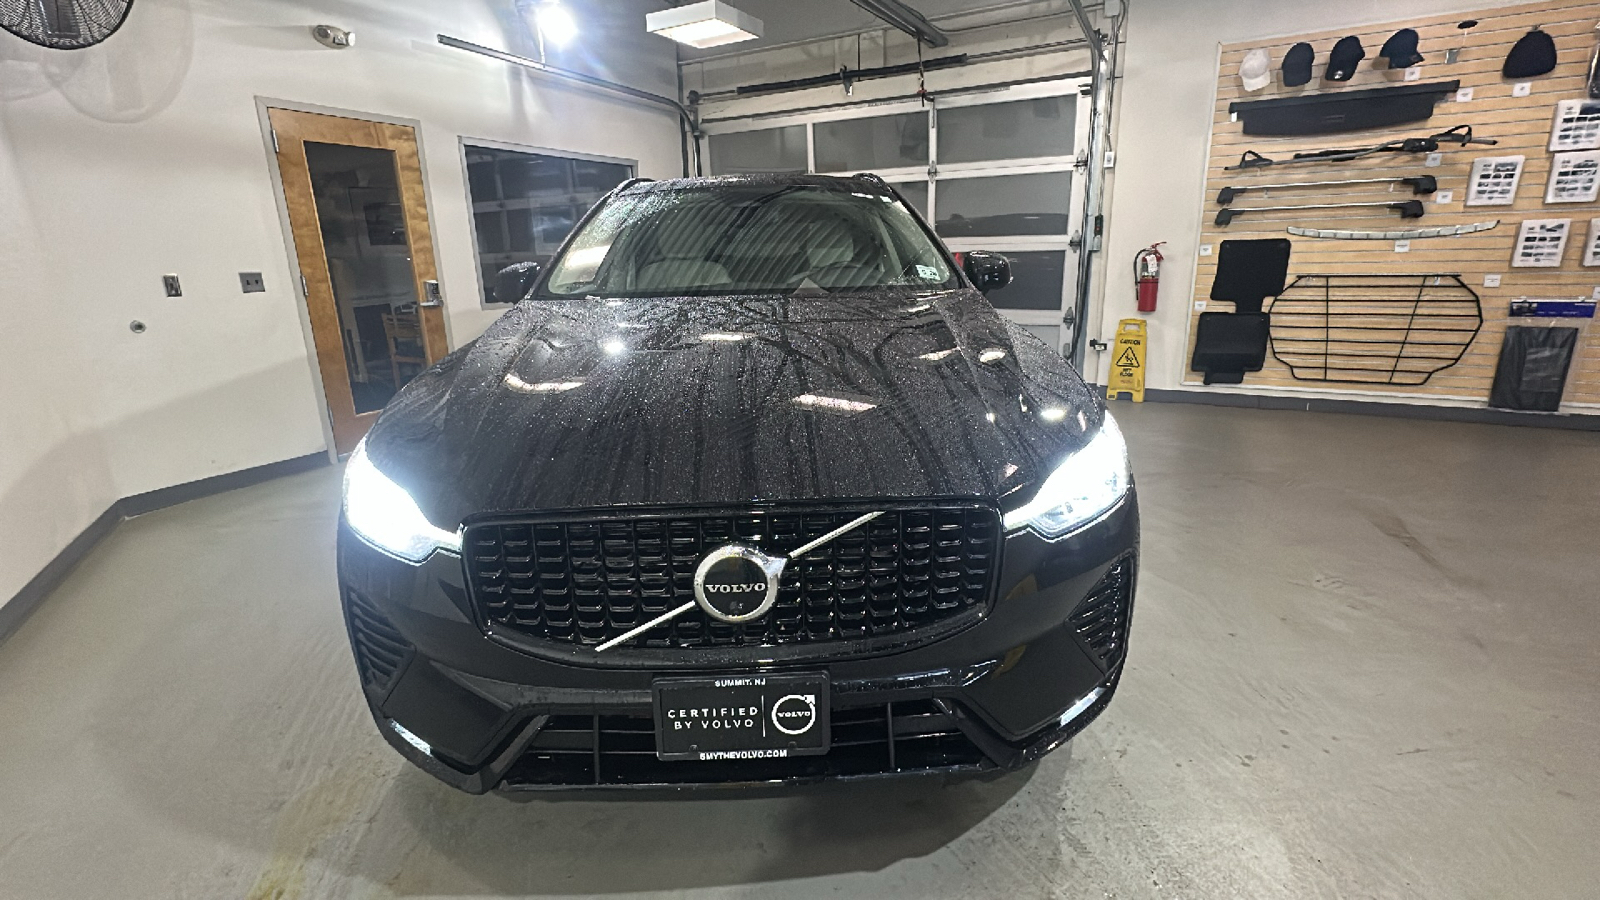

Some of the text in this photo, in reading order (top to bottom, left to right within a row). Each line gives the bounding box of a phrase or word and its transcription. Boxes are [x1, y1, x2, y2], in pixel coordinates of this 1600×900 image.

[705, 583, 766, 593] VOLVO
[667, 707, 758, 718] CERTIFIED
[674, 719, 754, 729] BY VOLVO
[700, 750, 787, 760] SMYTHEVOLVO.COM
